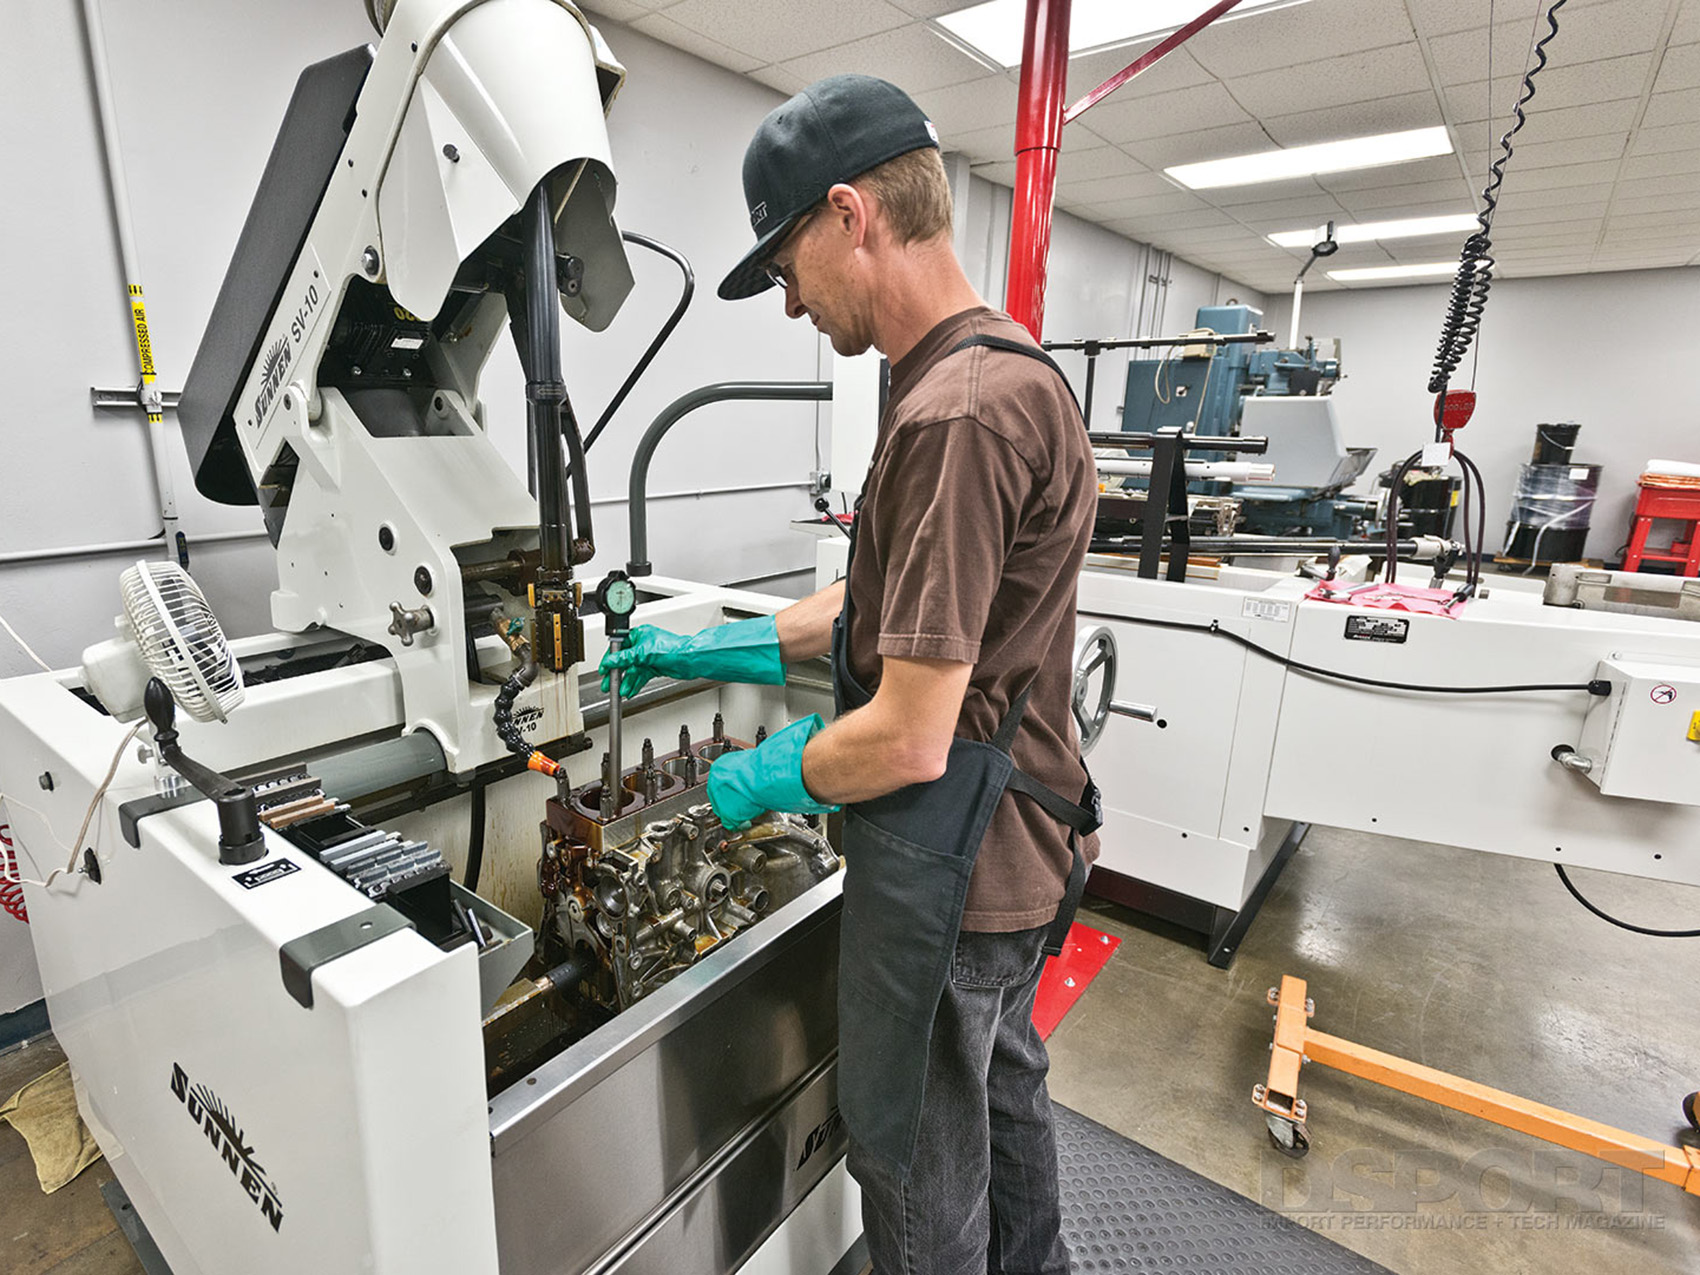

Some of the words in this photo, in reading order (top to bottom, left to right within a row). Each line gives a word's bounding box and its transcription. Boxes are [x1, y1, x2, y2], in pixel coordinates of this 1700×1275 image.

[133, 308, 146, 323] AIR
[254, 342, 292, 429] SUNNEN
[291, 284, 319, 344] SV-10
[513, 711, 544, 726] NNEN
[170, 1061, 284, 1234] SUNNEN
